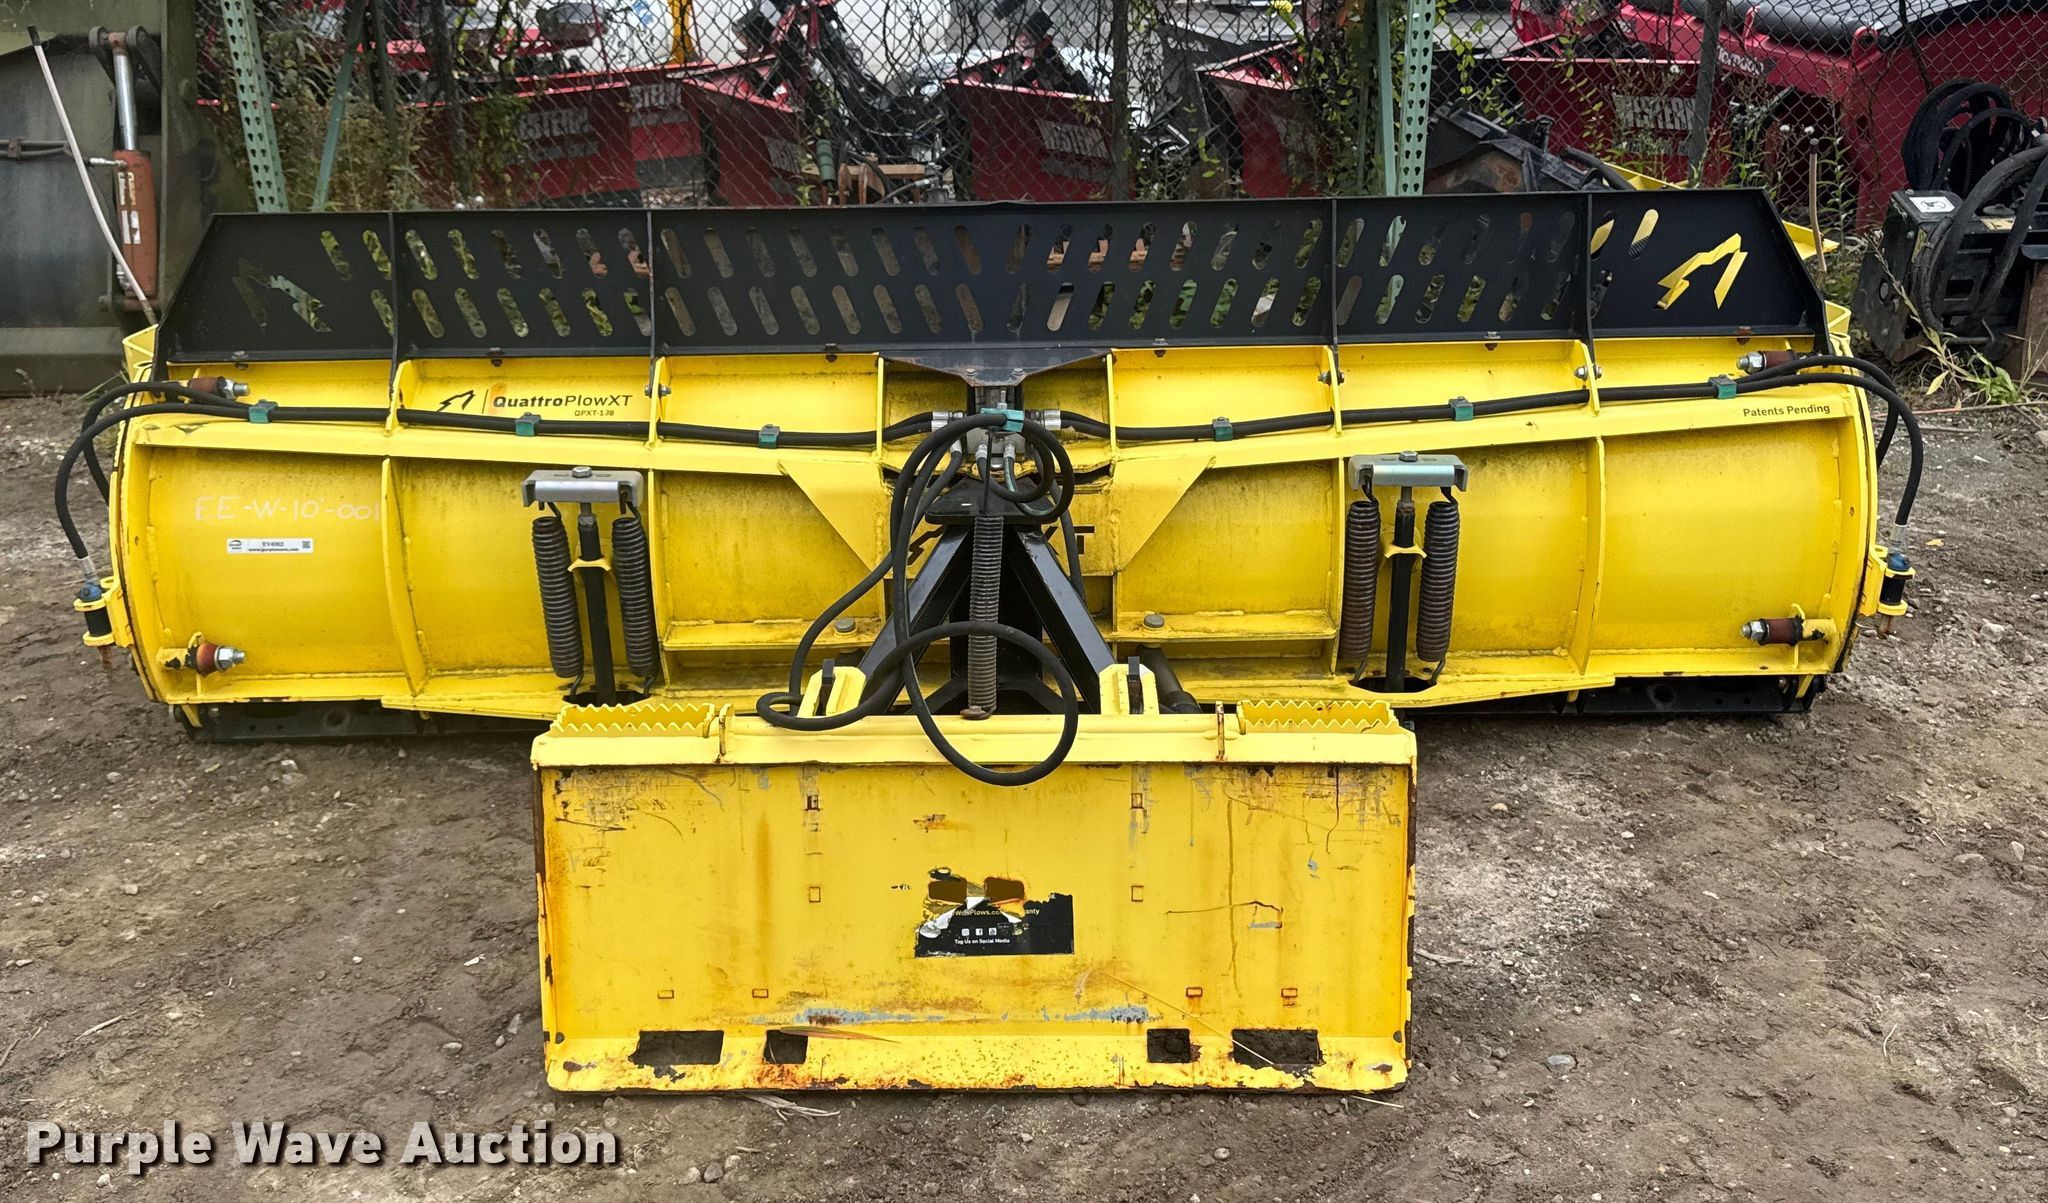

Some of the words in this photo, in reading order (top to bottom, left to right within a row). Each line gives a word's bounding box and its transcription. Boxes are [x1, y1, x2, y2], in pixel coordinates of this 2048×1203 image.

[493, 394, 633, 408] QuattroPlowXT
[1743, 407, 1784, 417] Patents
[1787, 404, 1830, 415] Pending
